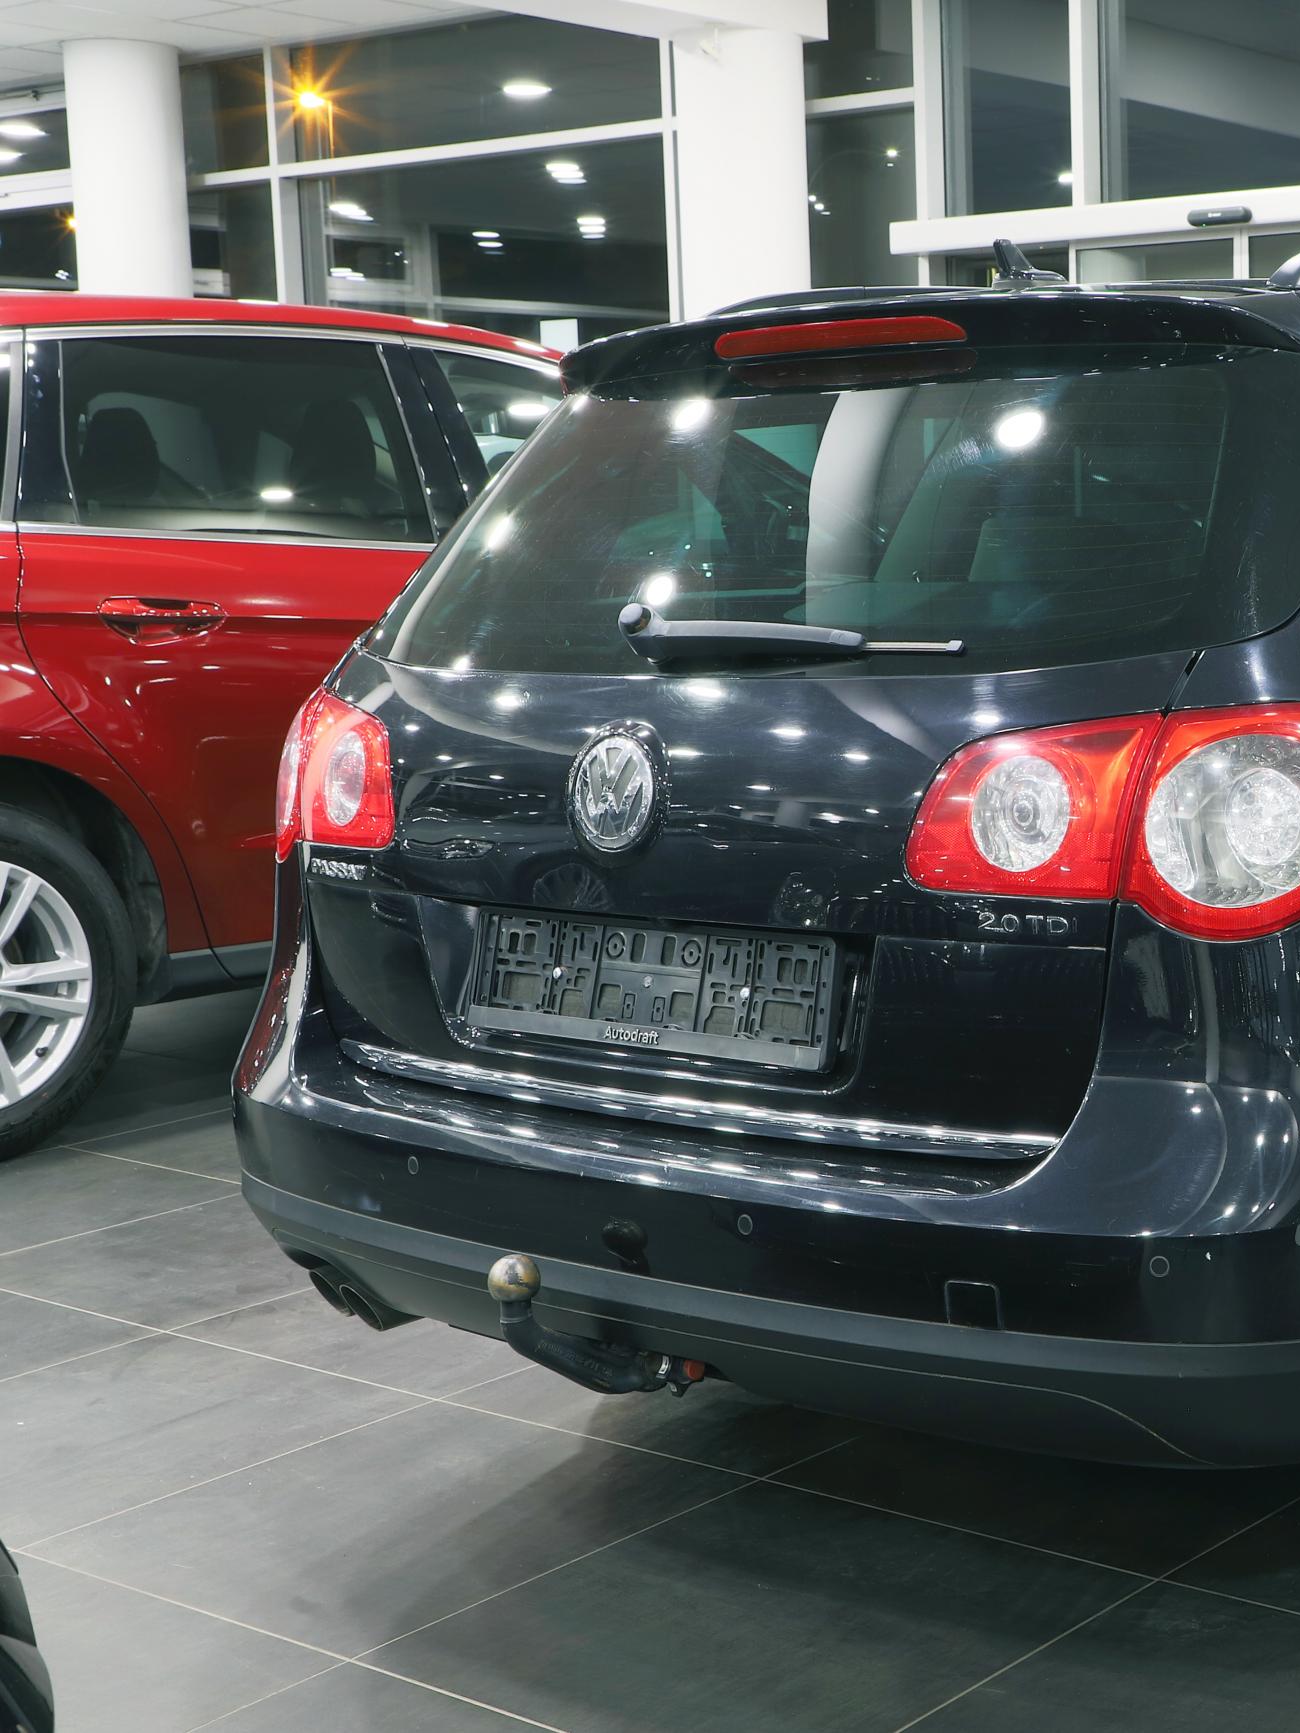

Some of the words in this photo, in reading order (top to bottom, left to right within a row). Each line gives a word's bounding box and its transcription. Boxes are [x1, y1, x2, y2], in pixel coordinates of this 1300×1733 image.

[576, 737, 653, 849] VW
[311, 858, 367, 880] PASSAT
[1026, 914, 1078, 935] TDI
[603, 1025, 659, 1045] Autodraft
